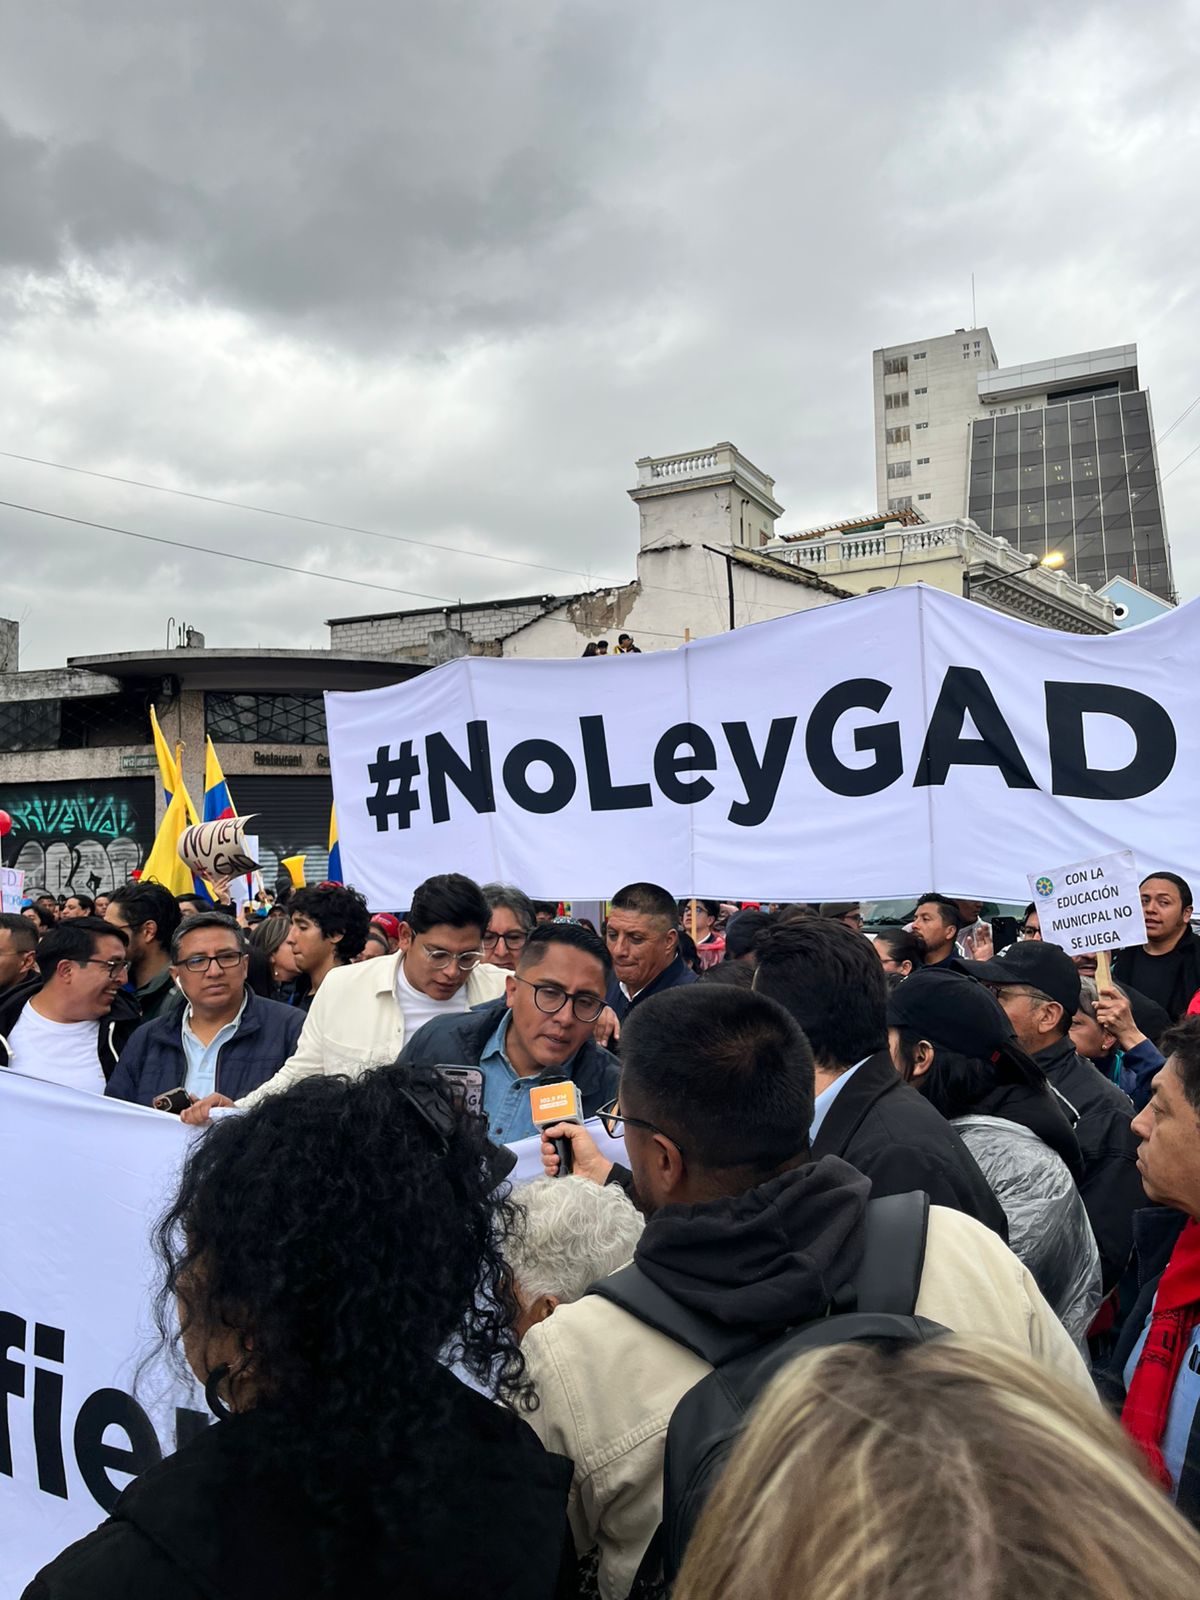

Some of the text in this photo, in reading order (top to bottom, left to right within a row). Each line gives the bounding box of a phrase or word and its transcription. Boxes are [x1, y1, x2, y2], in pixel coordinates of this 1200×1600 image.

[254, 751, 302, 766] Restaurant
[367, 666, 1176, 832] #NoLeyGAD
[1065, 867, 1104, 886] CON LA
[1057, 884, 1119, 909] EDUCACIÓN
[1052, 905, 1133, 932] MUNICIPAL NO
[1071, 930, 1121, 950] SE JUEGA
